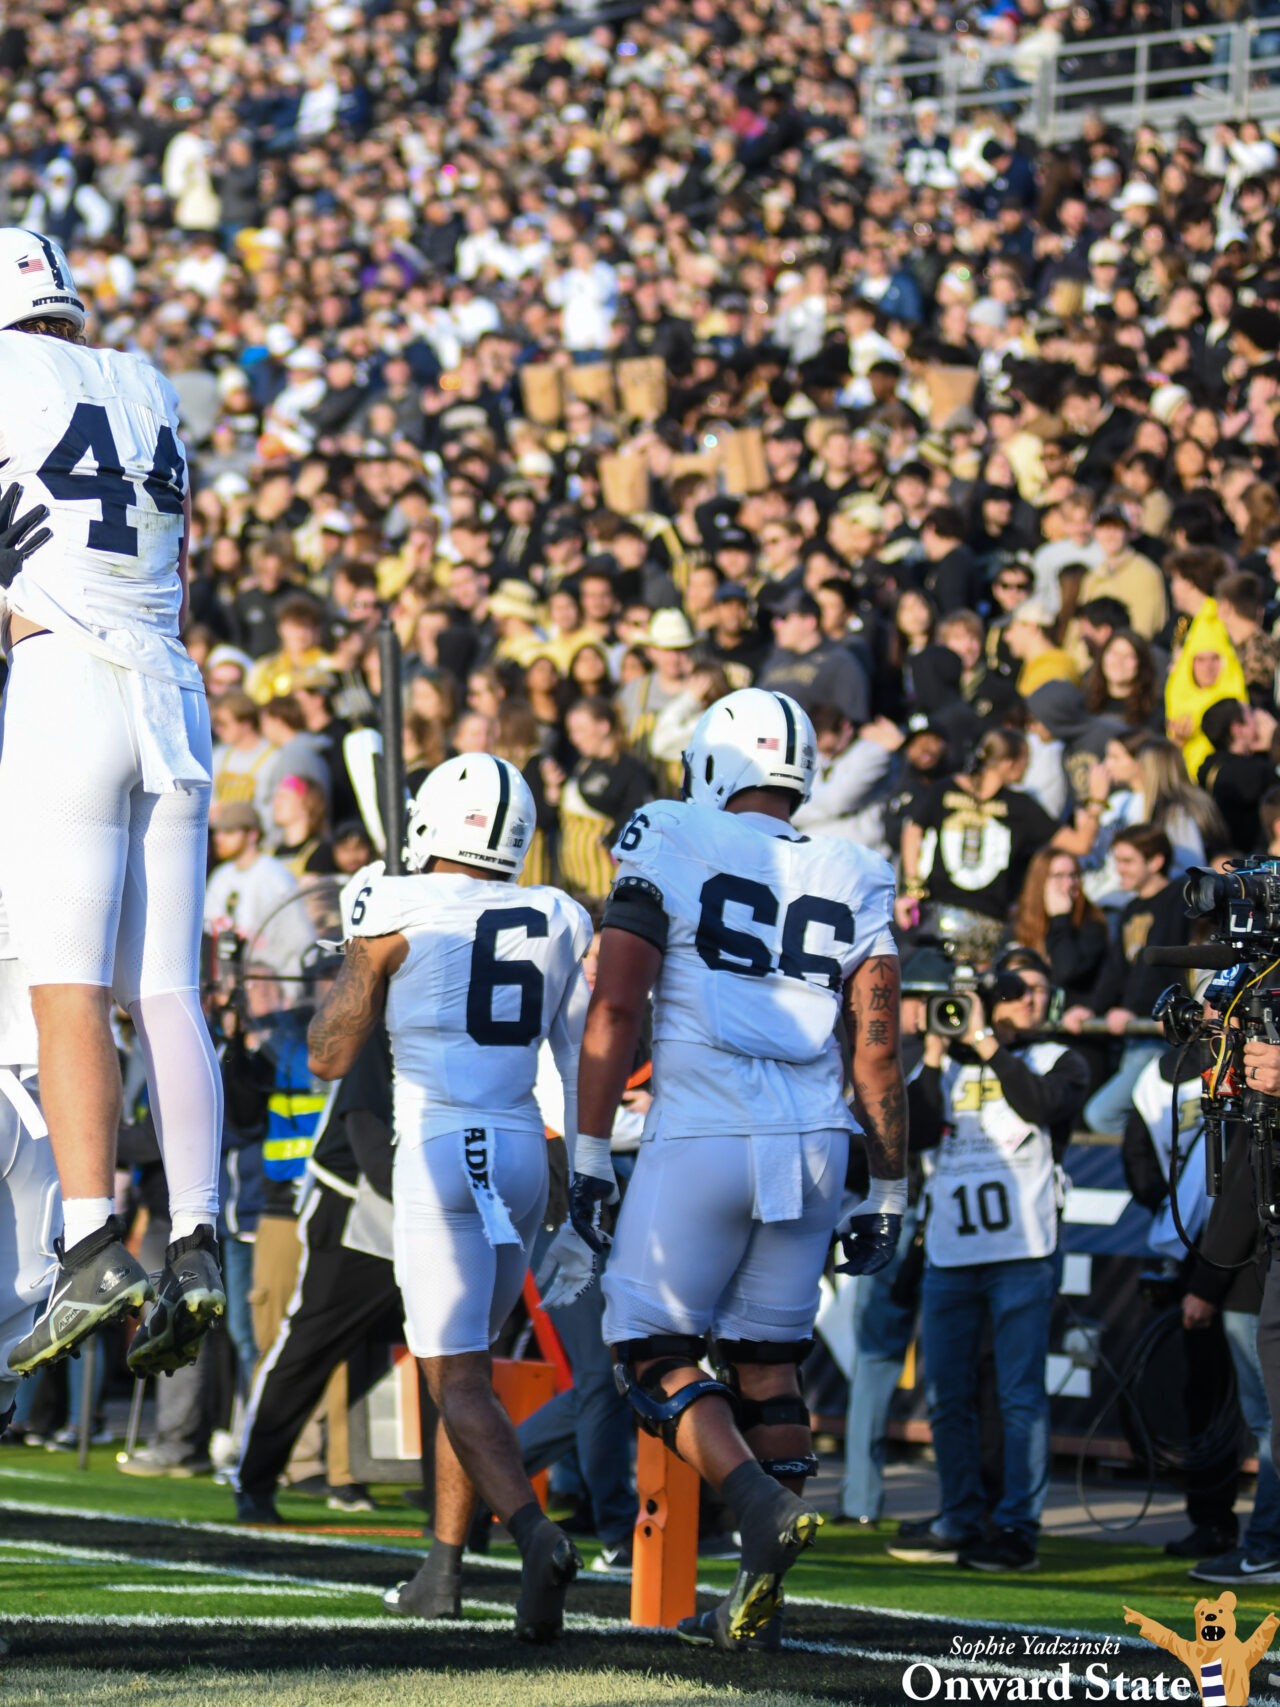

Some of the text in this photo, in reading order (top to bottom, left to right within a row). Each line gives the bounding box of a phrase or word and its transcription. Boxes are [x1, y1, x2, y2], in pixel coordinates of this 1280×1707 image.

[36, 402, 185, 558] 44
[351, 886, 372, 926] 6
[694, 872, 856, 994] 66
[466, 906, 549, 1047] 6
[952, 1181, 1012, 1237] 10
[59, 1308, 81, 1333] ALPHA
